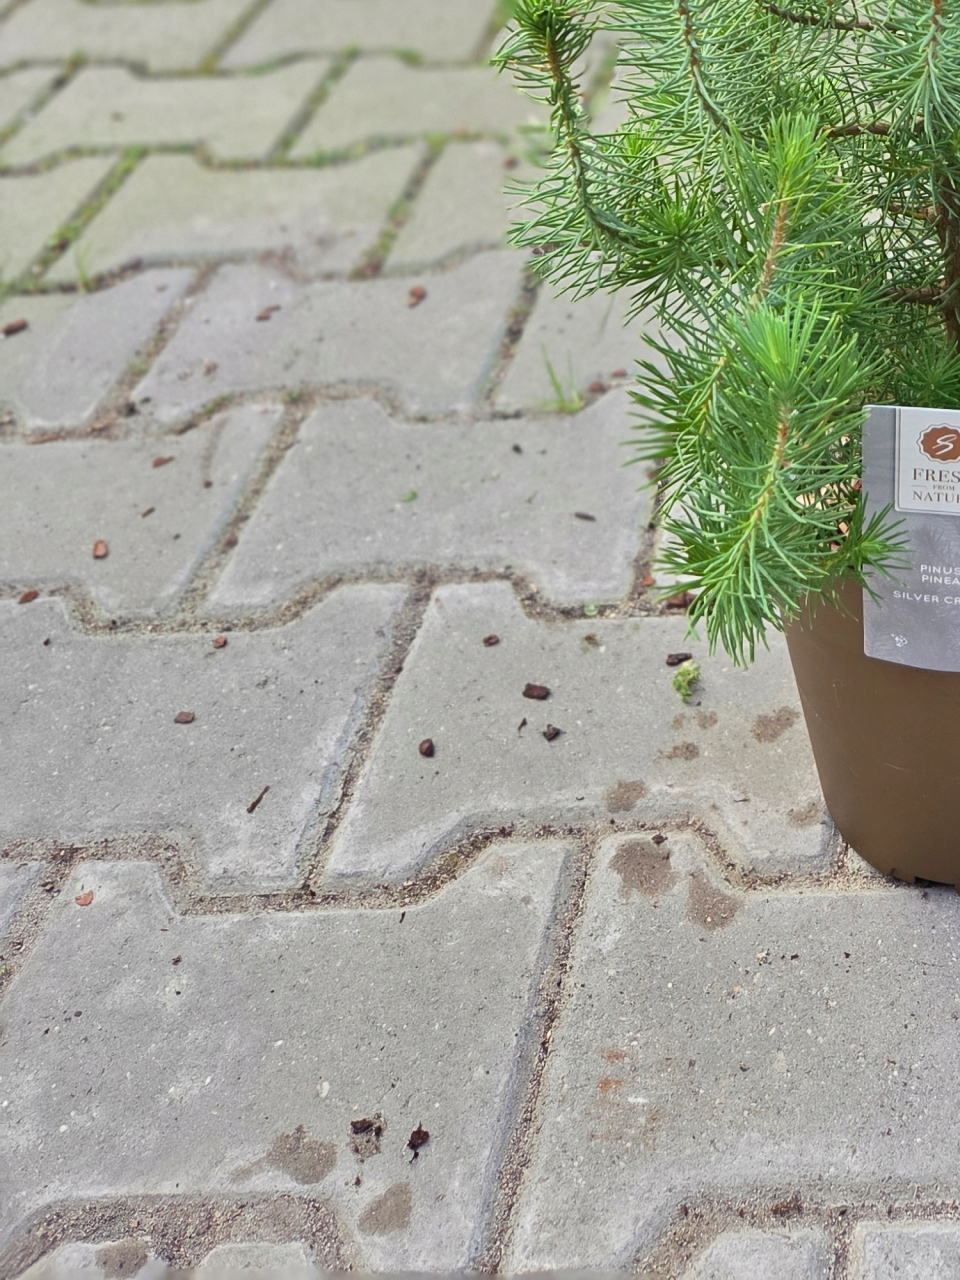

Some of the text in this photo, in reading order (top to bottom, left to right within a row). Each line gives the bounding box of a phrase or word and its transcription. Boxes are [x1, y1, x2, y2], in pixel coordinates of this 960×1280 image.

[932, 484, 955, 492] FROM
[921, 575, 960, 585] PINEA
[893, 590, 939, 603] SILVER
